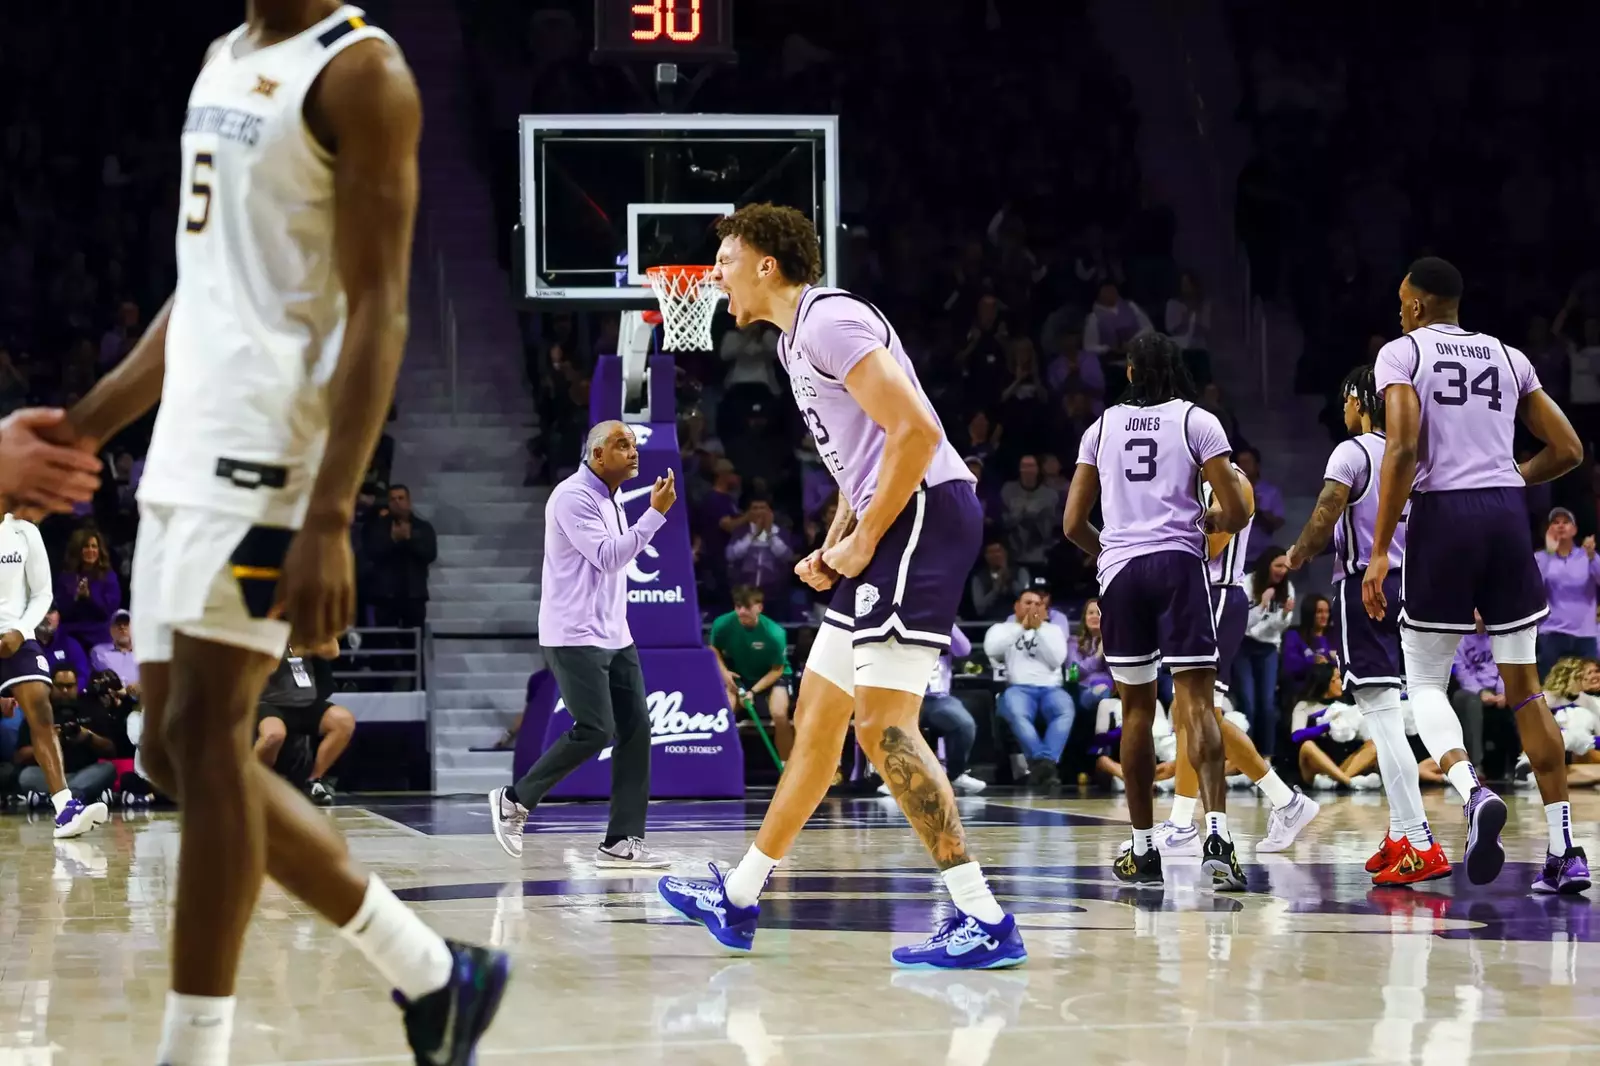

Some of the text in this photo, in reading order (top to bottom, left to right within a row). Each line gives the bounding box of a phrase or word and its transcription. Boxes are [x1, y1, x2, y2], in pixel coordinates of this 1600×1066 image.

[632, 0, 700, 41] 30
[185, 153, 214, 233] 5
[1435, 342, 1491, 360] ONYENSO
[1433, 361, 1502, 412] 34
[1125, 417, 1160, 431] JONES
[1125, 438, 1158, 482] 3
[0, 551, 22, 564] cats
[627, 585, 685, 603] annel.
[646, 690, 729, 734] llons
[664, 745, 688, 754] FOOD
